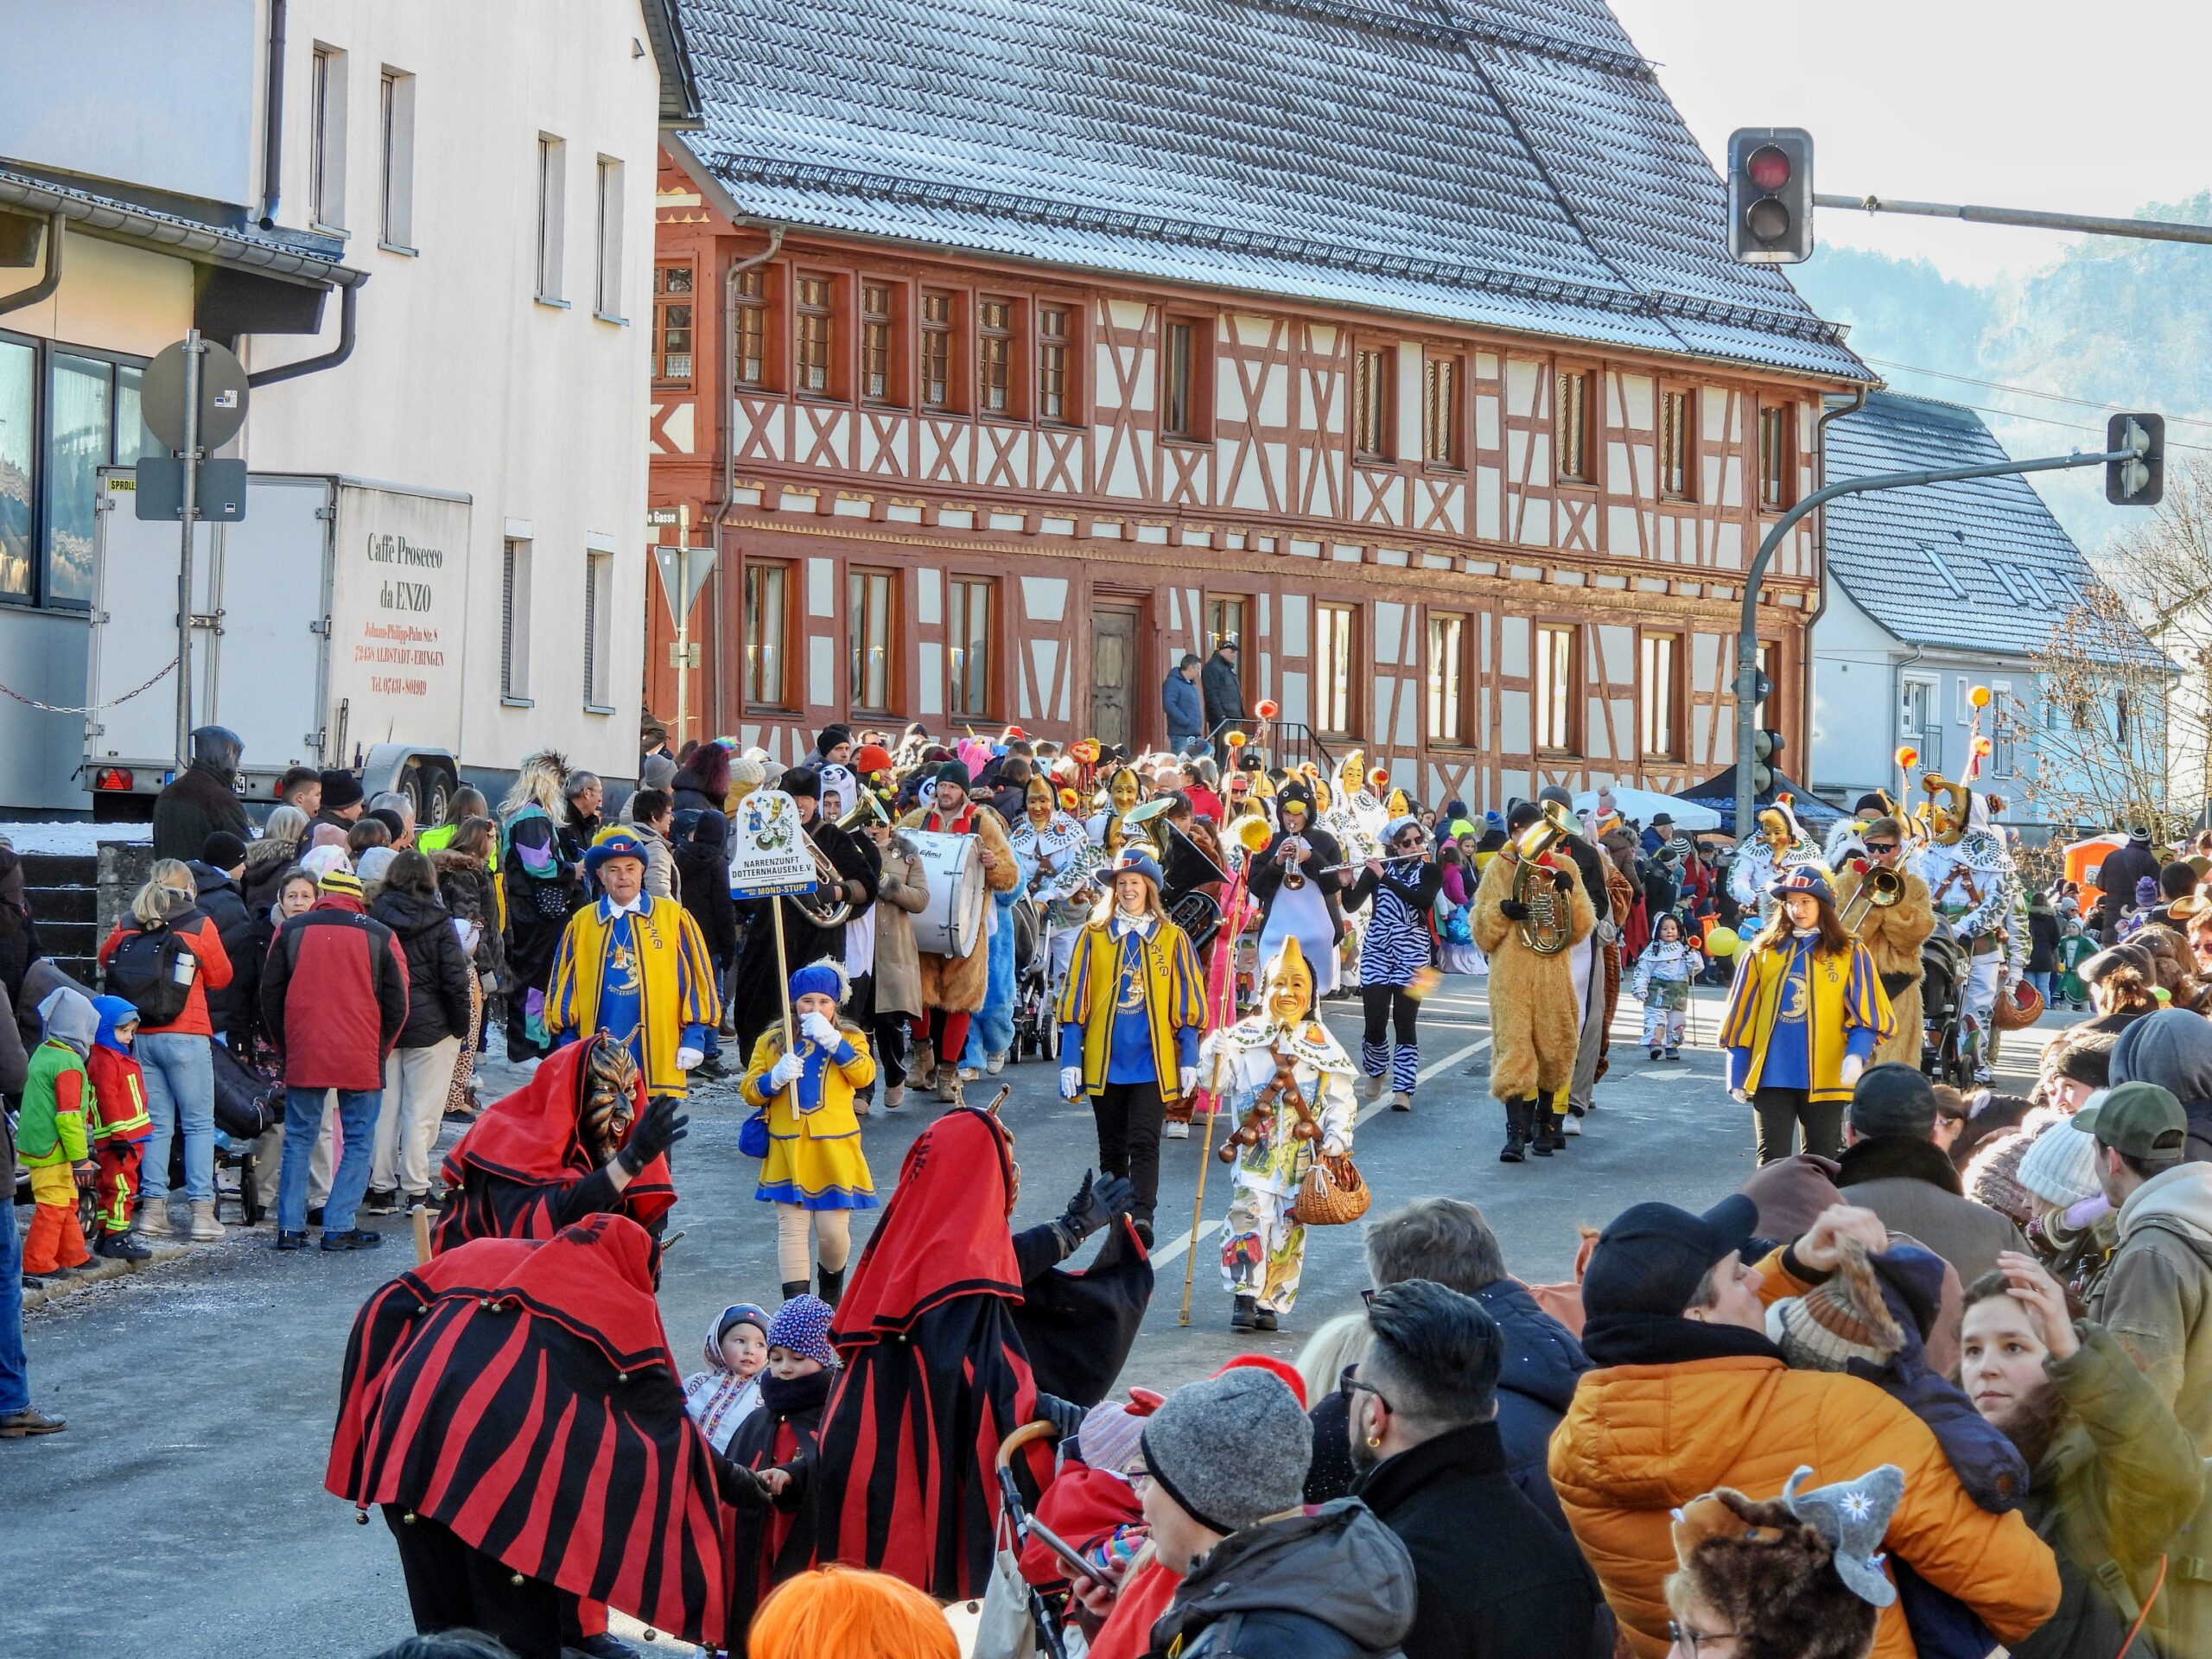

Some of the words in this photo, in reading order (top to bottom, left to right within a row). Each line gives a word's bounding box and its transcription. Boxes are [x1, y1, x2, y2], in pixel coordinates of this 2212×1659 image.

[654, 511, 677, 524] Gasse
[397, 536, 442, 569] Prosecco
[380, 580, 393, 608] da
[396, 581, 431, 613] ENZO
[376, 646, 411, 664] ALBSTADT
[414, 650, 444, 667] EBINGEN
[744, 855, 799, 868] NARRENZUNFT
[732, 865, 799, 879] DOTTERNHAUSEN
[758, 883, 809, 896] MOND-STUPF
